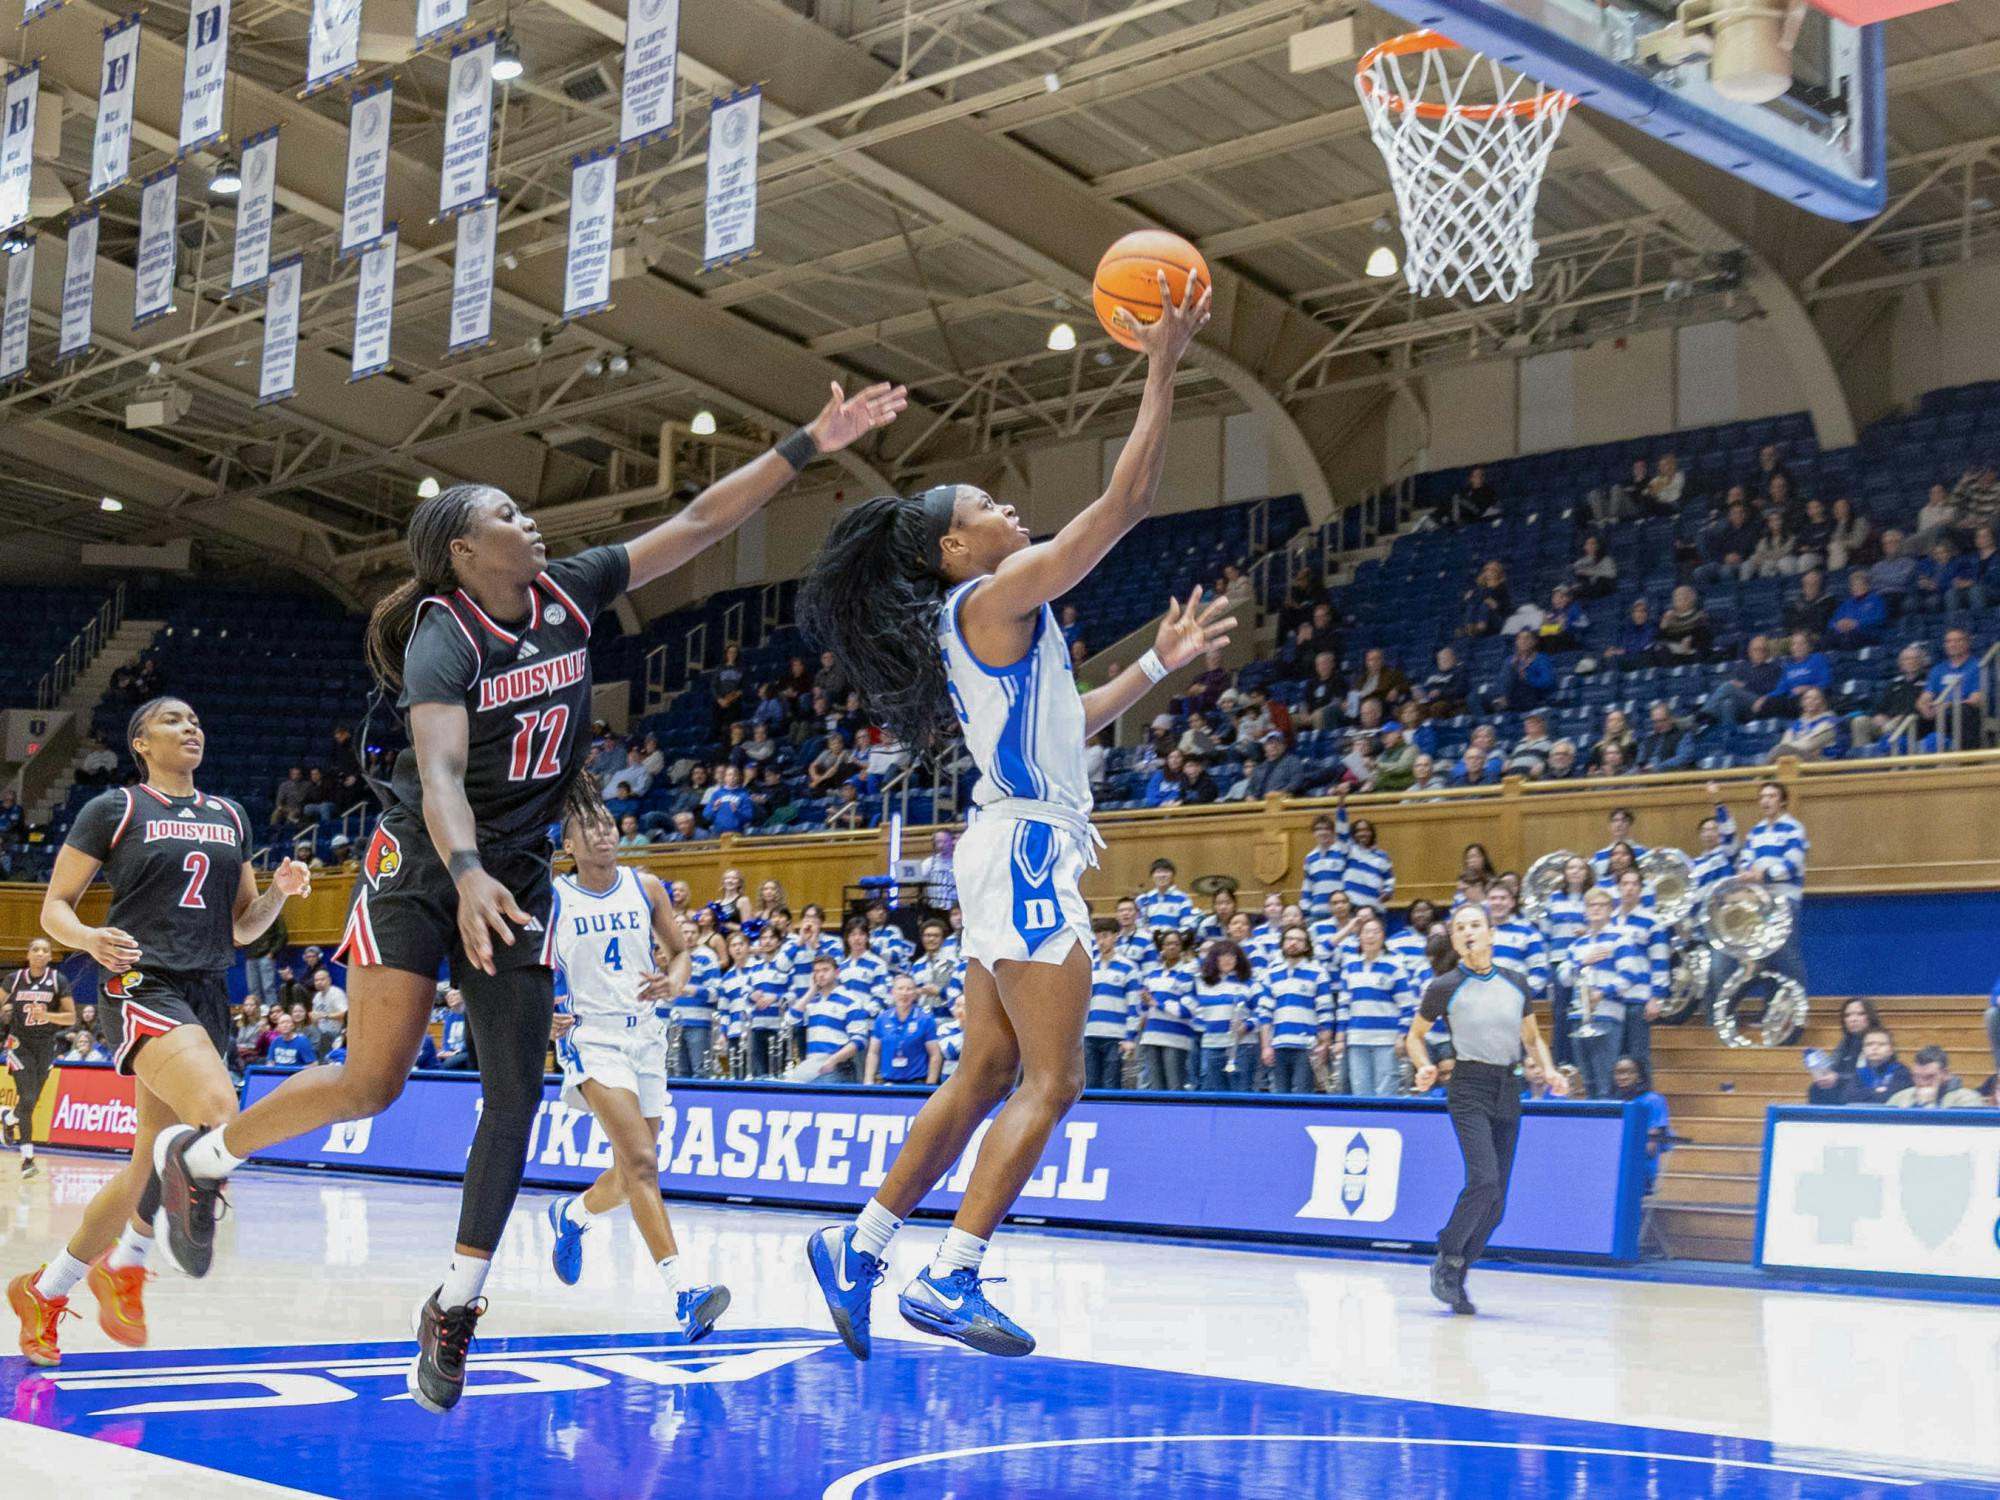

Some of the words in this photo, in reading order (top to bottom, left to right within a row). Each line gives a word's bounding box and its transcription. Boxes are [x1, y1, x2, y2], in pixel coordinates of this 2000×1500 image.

[634, 26, 667, 50] ATLANTIC
[639, 44, 661, 63] COAST
[625, 55, 672, 84] CONFERENCE
[627, 71, 669, 98] CHAMPIONS
[453, 104, 483, 126] ATLANTIC
[457, 121, 477, 138] COAST
[445, 131, 486, 156] CONFERENCE
[355, 149, 381, 173] ATLANTIC
[446, 146, 484, 170] CHAMPIONS
[357, 164, 376, 180] COAST
[720, 172, 741, 190] COAST
[347, 174, 385, 197] CONFERENCE
[348, 188, 382, 211] CHAMPIONS
[710, 198, 752, 220] CHAMPIONS
[576, 214, 606, 232] ATLANTIC
[570, 240, 610, 262] CONFERENCE
[571, 254, 606, 274] CHAMPIONS
[478, 647, 587, 712] LOUISVILLE
[508, 704, 570, 782] 12
[144, 819, 236, 847] LOUISVILLE
[178, 851, 211, 909] 2
[574, 910, 641, 936] DUKE
[1024, 898, 1057, 930] D
[604, 936, 622, 972] 4
[53, 1094, 137, 1134] Ameritas
[656, 1103, 1108, 1201] BASKETL
